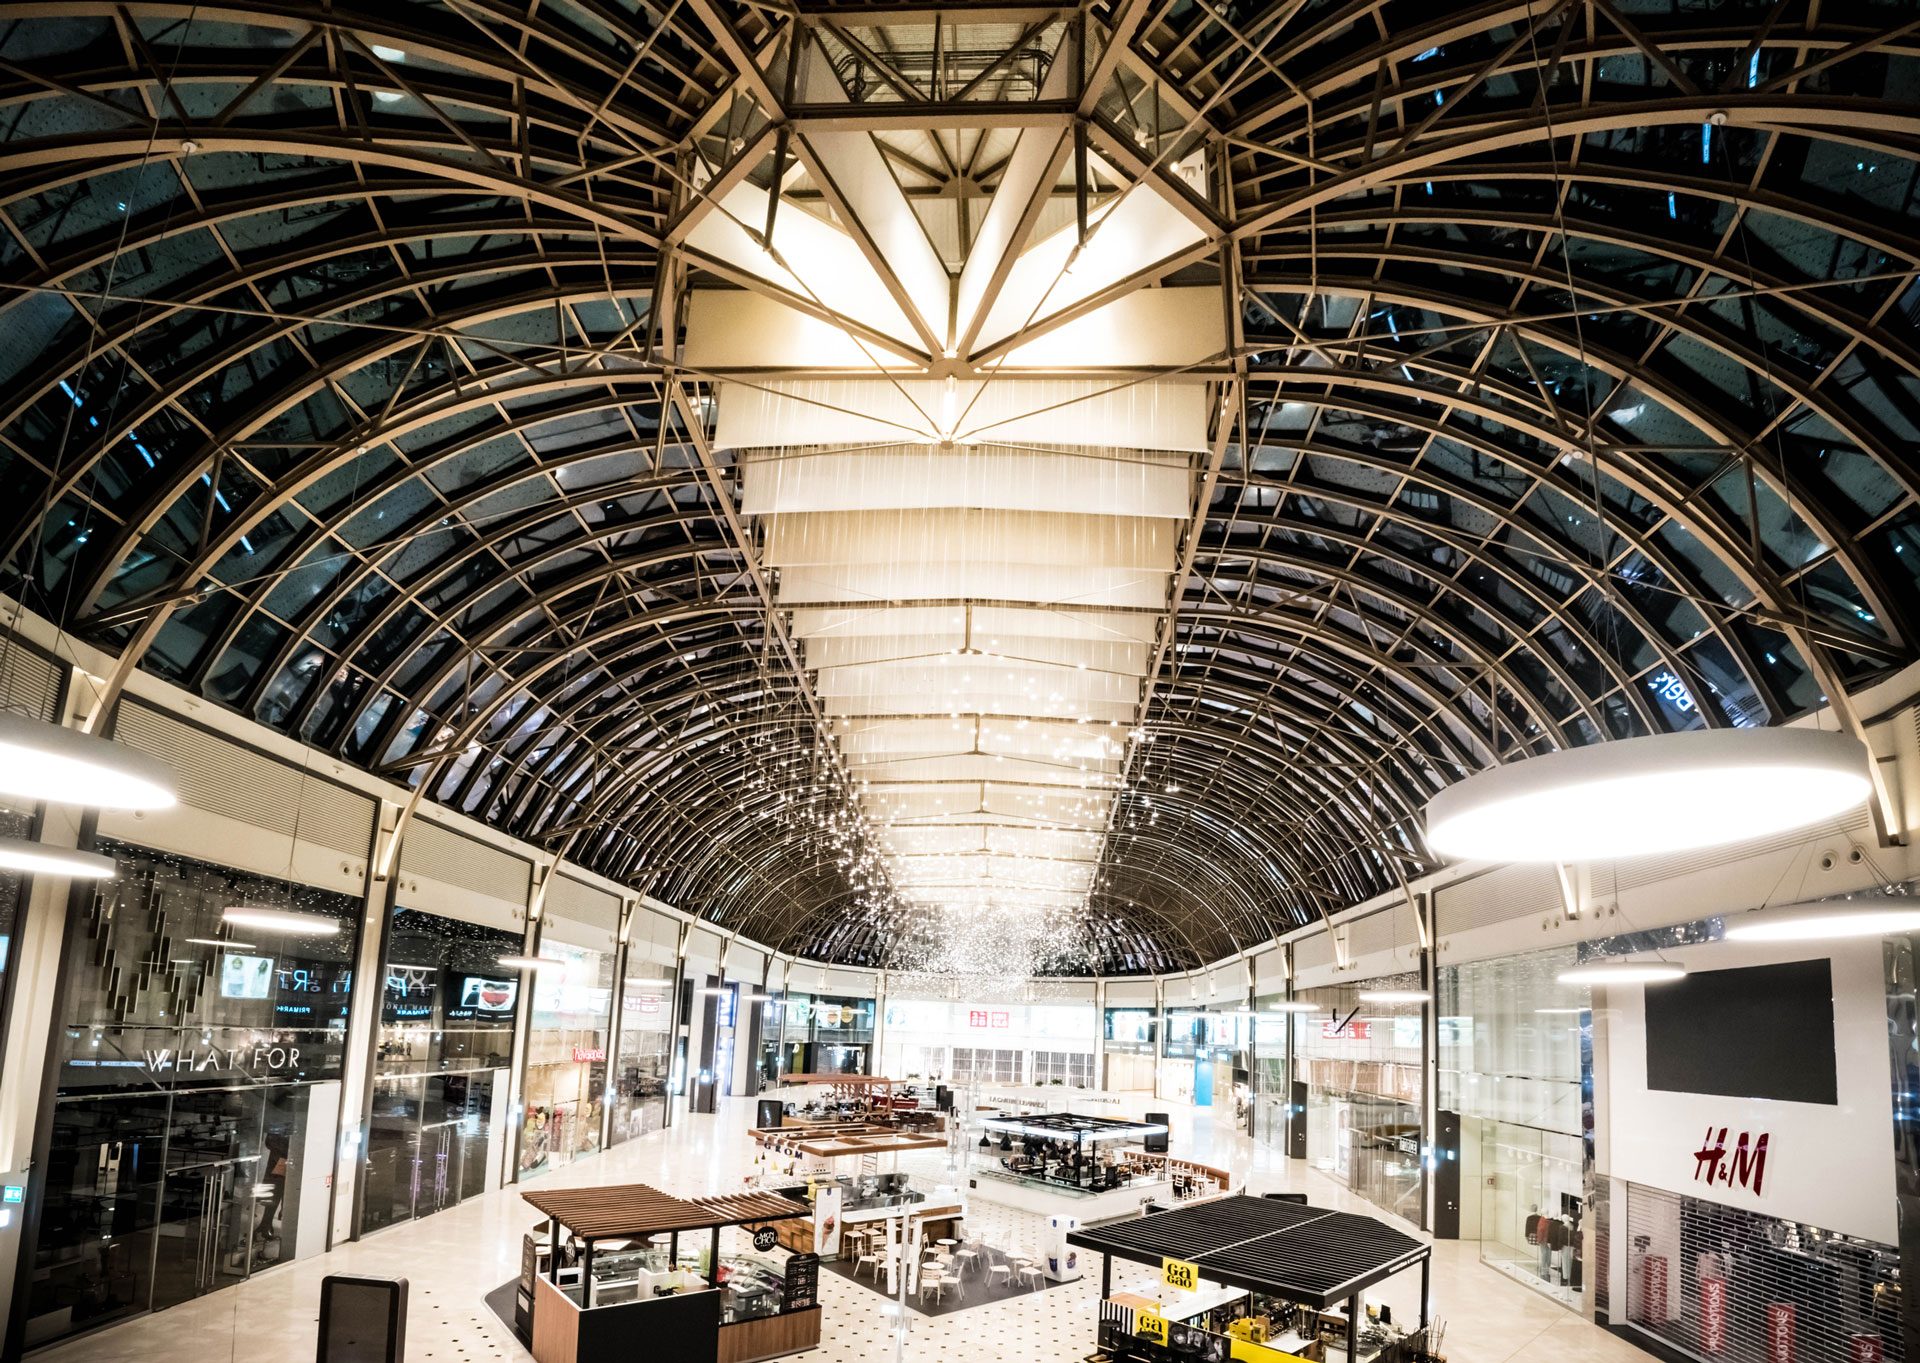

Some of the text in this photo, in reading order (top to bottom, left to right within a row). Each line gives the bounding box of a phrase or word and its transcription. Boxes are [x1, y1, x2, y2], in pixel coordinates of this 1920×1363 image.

[144, 1047, 301, 1073] WHAT FOR
[763, 1142, 803, 1160] GROM
[1693, 1126, 1769, 1197] H&M
[754, 1235, 778, 1245] CHOU
[1708, 1282, 1720, 1351] PROMOTIONS
